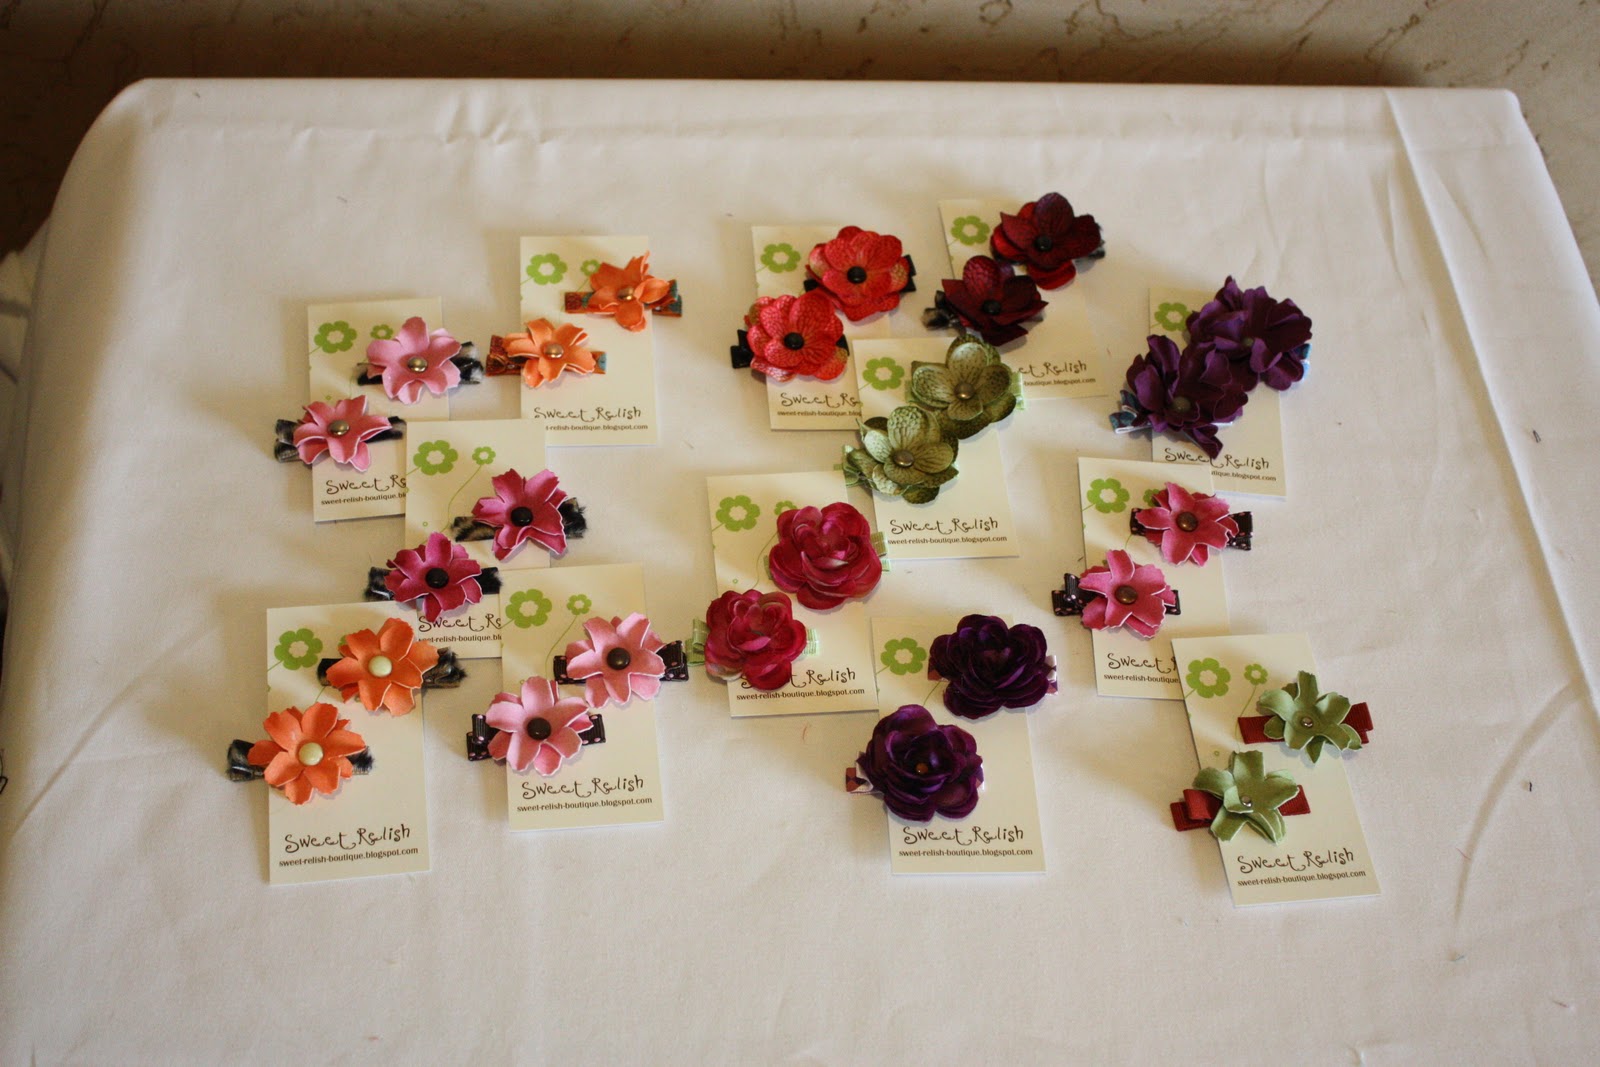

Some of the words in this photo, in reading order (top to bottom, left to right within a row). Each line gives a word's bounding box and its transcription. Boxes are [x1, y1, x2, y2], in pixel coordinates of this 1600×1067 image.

[1043, 360, 1087, 376] Relish
[780, 392, 840, 408] Sweet
[533, 407, 595, 423] Sweet
[595, 406, 641, 421] Relish
[1224, 454, 1269, 470] Relish
[325, 477, 390, 495] Sweet
[889, 519, 953, 535] Sweet
[951, 516, 998, 533] Relish
[418, 615, 485, 633] Sweet
[1107, 652, 1172, 675] Sweet
[805, 667, 856, 686] Relish
[736, 687, 865, 701] sweet-relish-boutique.blogspot.com
[521, 780, 592, 800] Sweet
[591, 774, 644, 795] Relish
[516, 796, 653, 813] sweet-relish-boutique.blogspot.com
[284, 831, 357, 854] Sweet
[356, 823, 411, 846] Relish
[902, 825, 973, 846] Sweet
[971, 825, 1024, 844] Relish
[278, 847, 419, 867] sweet-relish-boutique.blogspot.com
[898, 847, 1034, 857] sweet-relish-boutique.blogspot.com
[1237, 854, 1307, 874] Sweet
[1302, 847, 1354, 869] Relish
[1237, 870, 1367, 887] sweet-relish-boutique.blogspot.com
